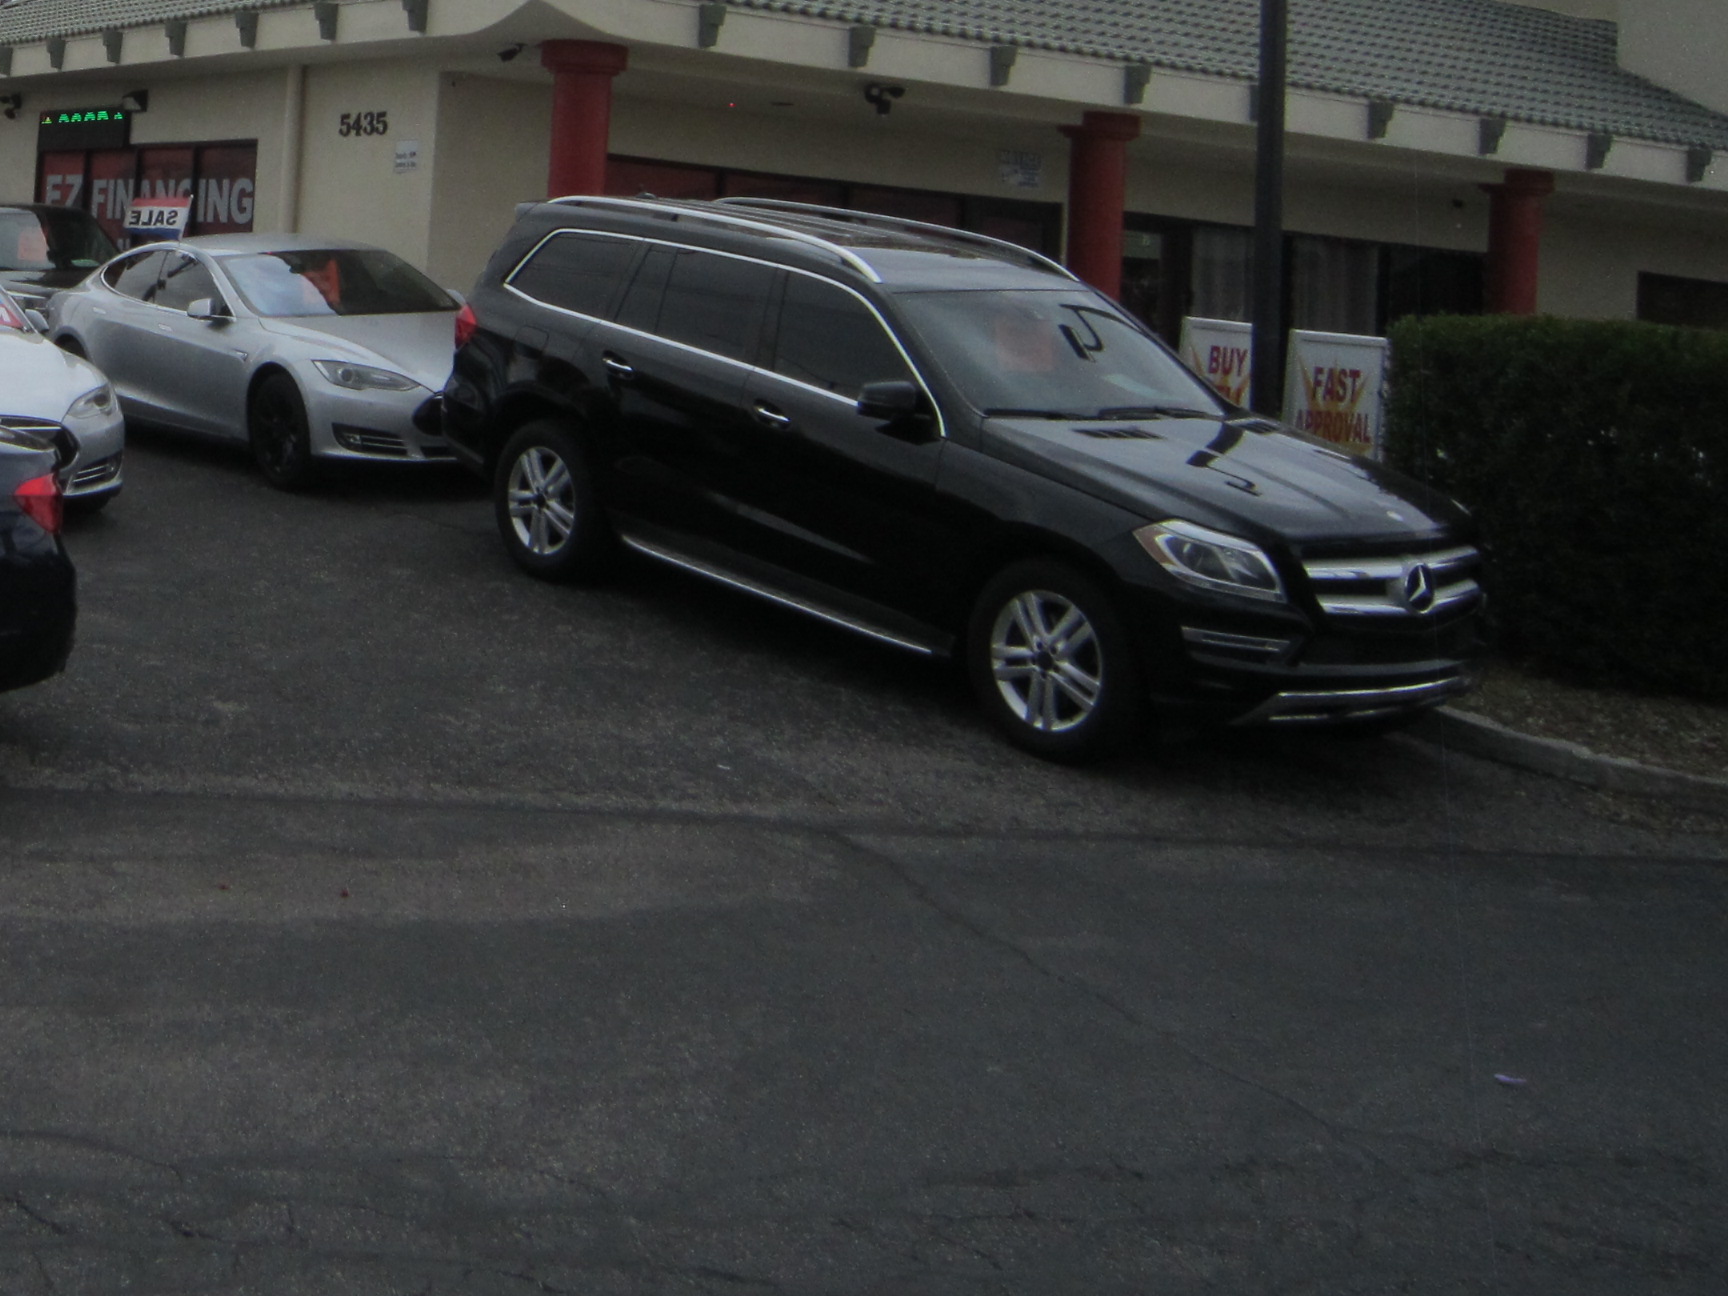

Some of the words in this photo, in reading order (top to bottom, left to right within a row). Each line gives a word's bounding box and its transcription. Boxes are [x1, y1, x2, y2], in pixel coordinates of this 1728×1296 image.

[339, 110, 388, 137] 5435
[1208, 345, 1248, 377] BUY
[1313, 366, 1361, 403] FAST
[1295, 409, 1371, 444] APPROVAL
